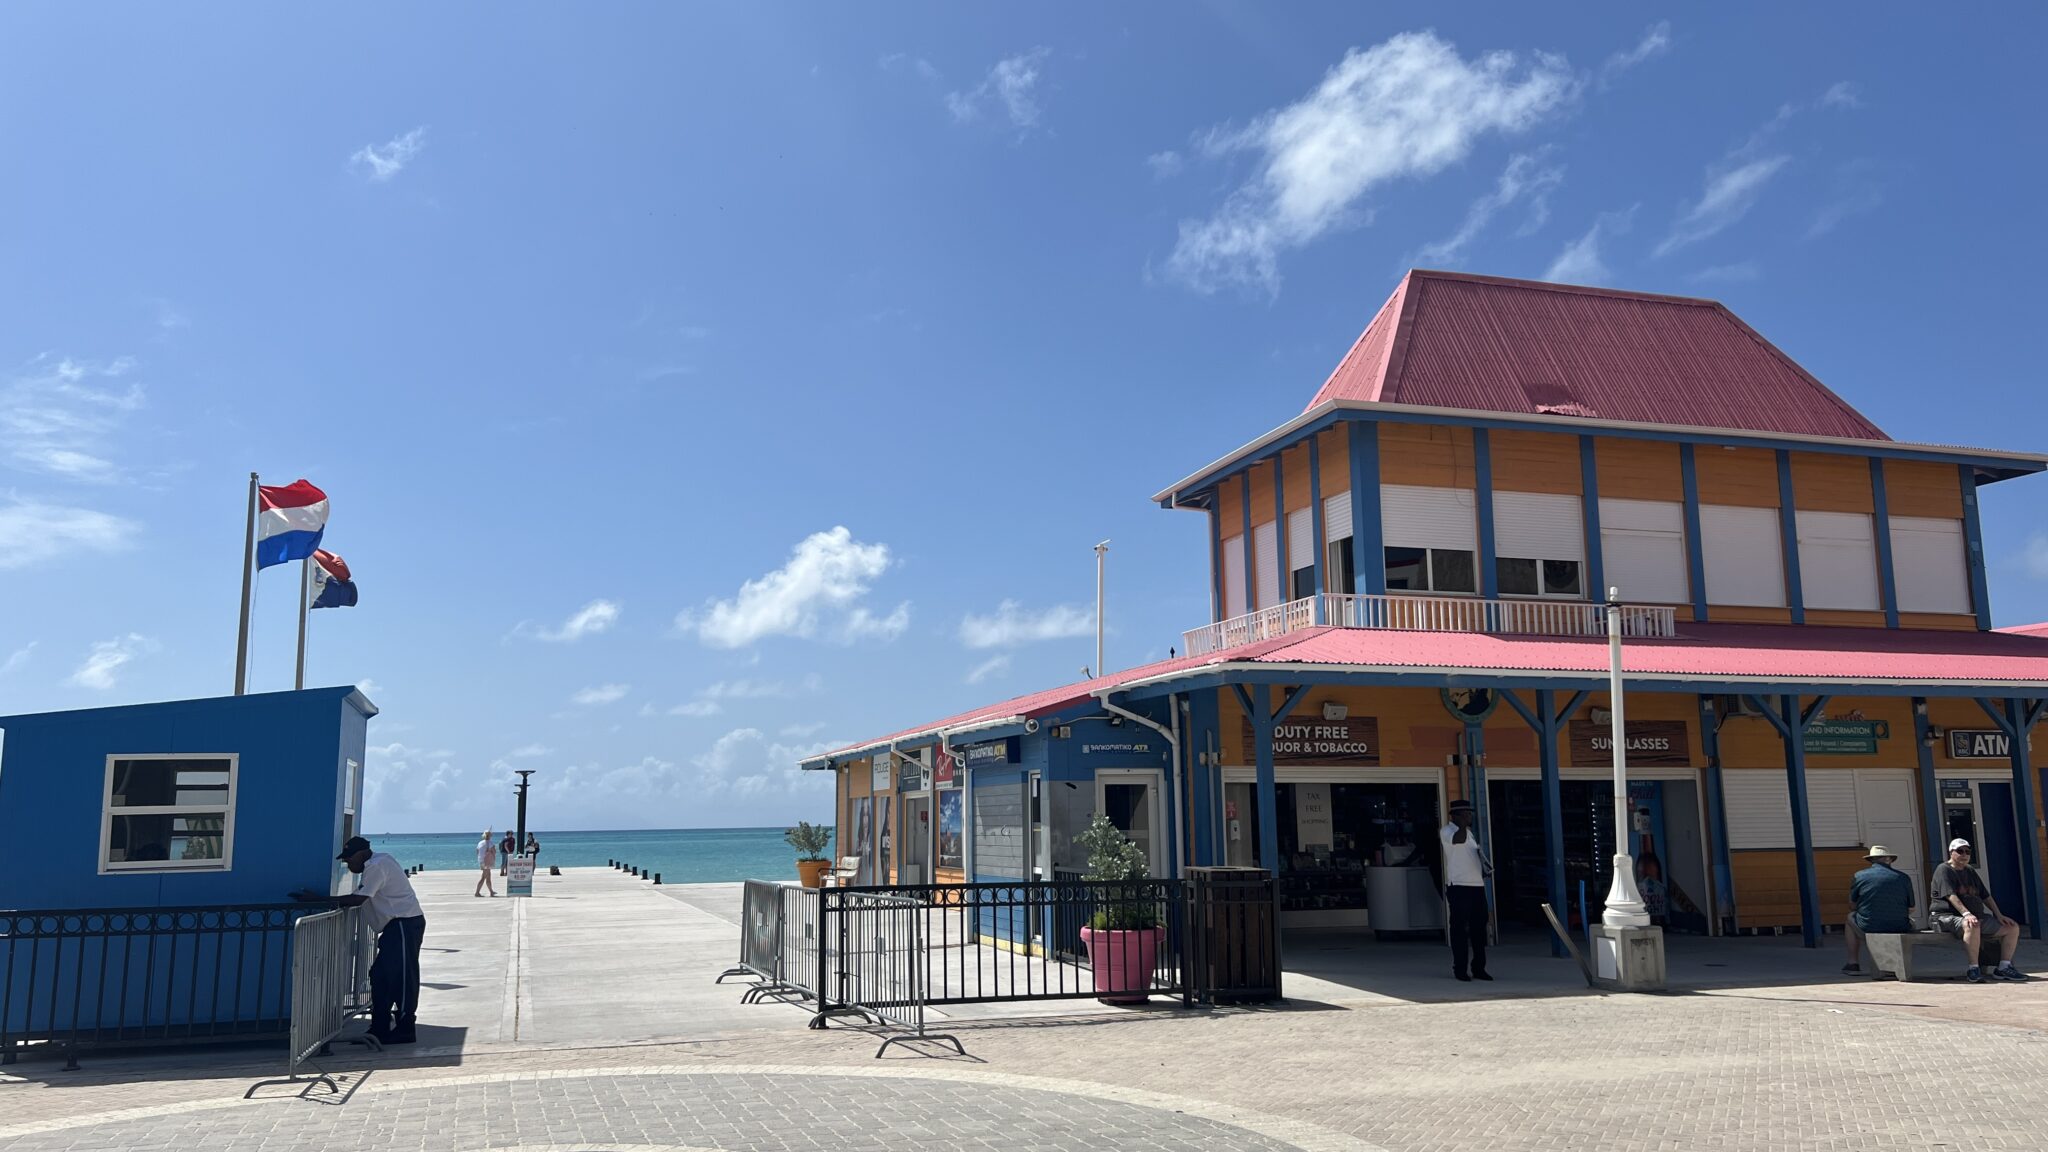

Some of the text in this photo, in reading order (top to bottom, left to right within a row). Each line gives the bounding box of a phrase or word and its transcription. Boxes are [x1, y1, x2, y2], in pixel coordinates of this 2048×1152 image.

[1274, 725, 1349, 740] DUTY FREE
[1823, 726, 1871, 735] INFORMATION
[1303, 742, 1312, 753] &
[1313, 742, 1368, 753] TOBACCO
[1591, 737, 1670, 750] SUNLASSES
[1305, 791, 1321, 801] TAX
[1305, 804, 1322, 813] FREE
